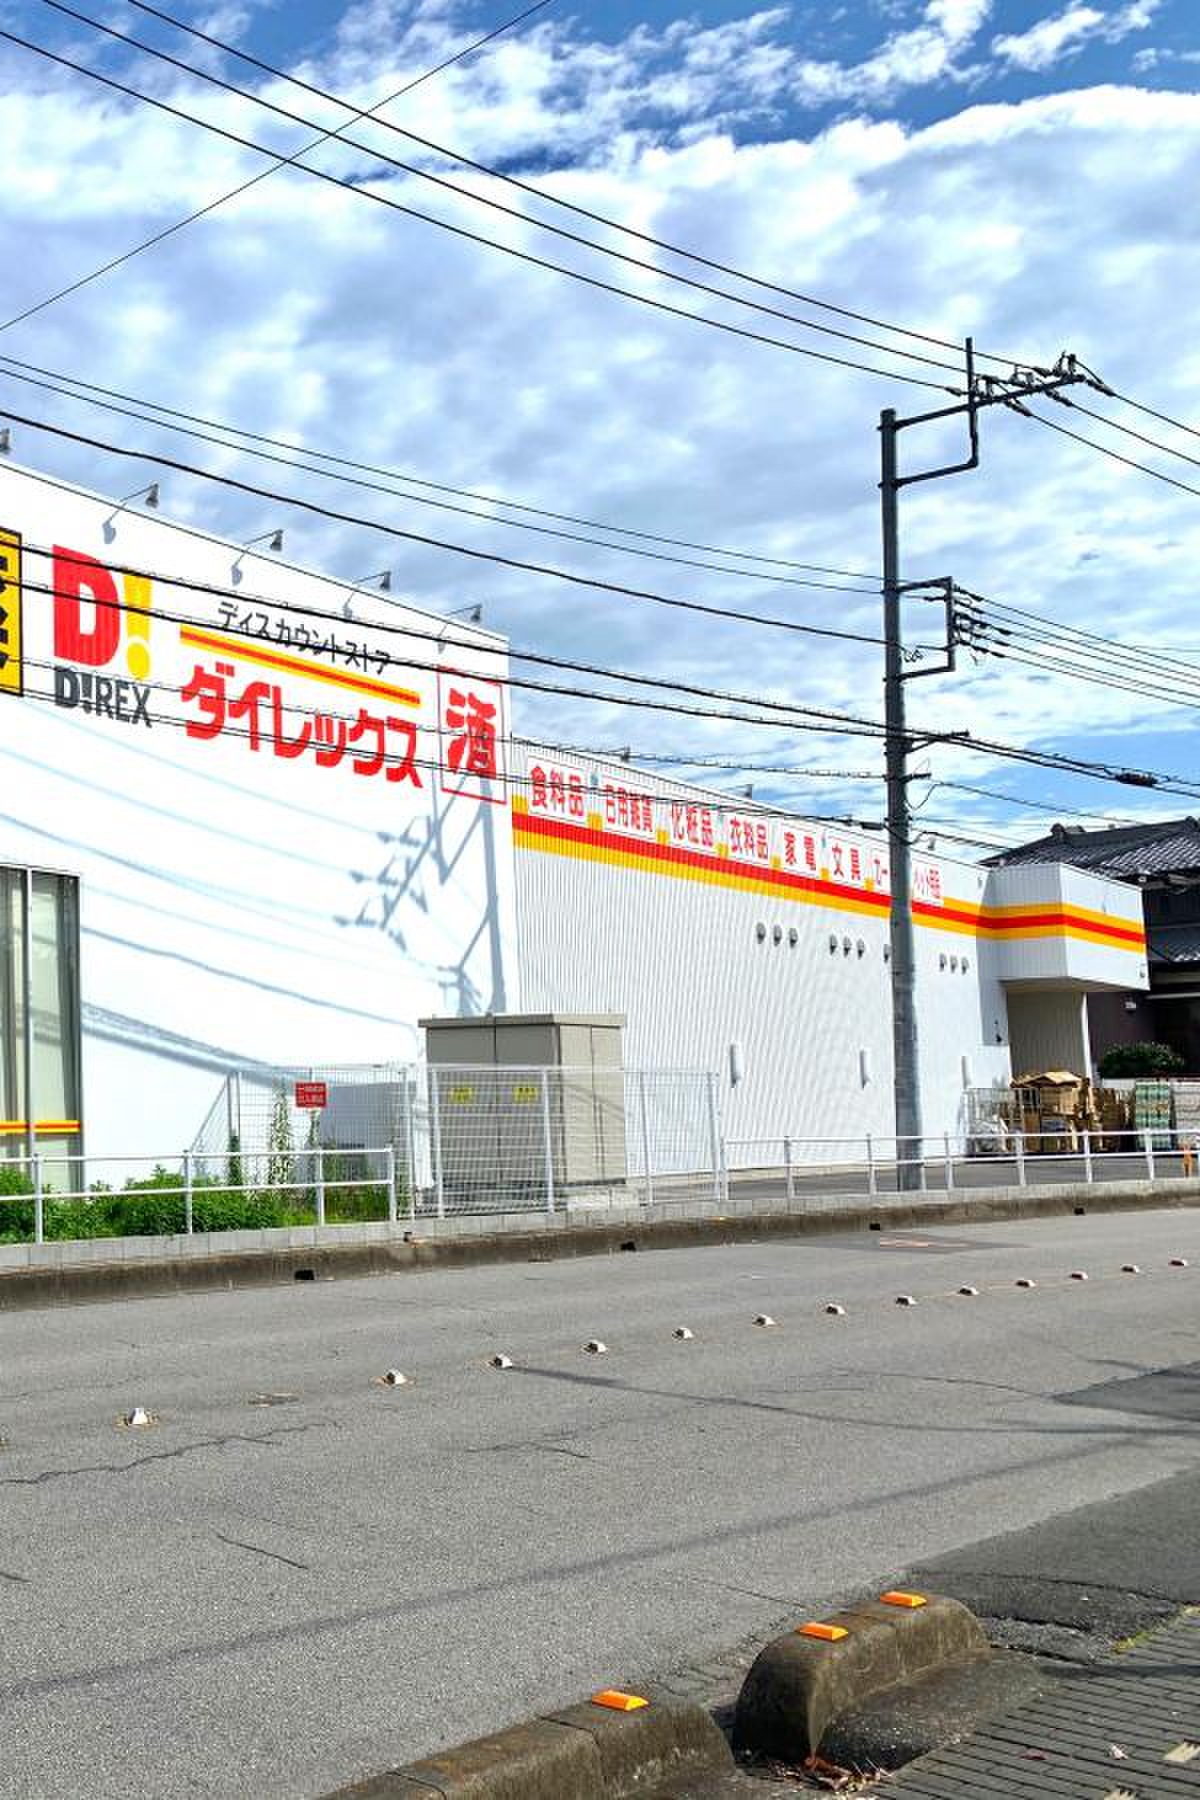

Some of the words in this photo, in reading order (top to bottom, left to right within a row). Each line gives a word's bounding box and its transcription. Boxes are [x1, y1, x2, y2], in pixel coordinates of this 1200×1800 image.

[216, 600, 393, 675] ディスカウントストア
[179, 657, 424, 790] ダイレックス
[446, 685, 498, 781] 酒
[530, 766, 584, 817] 食料品
